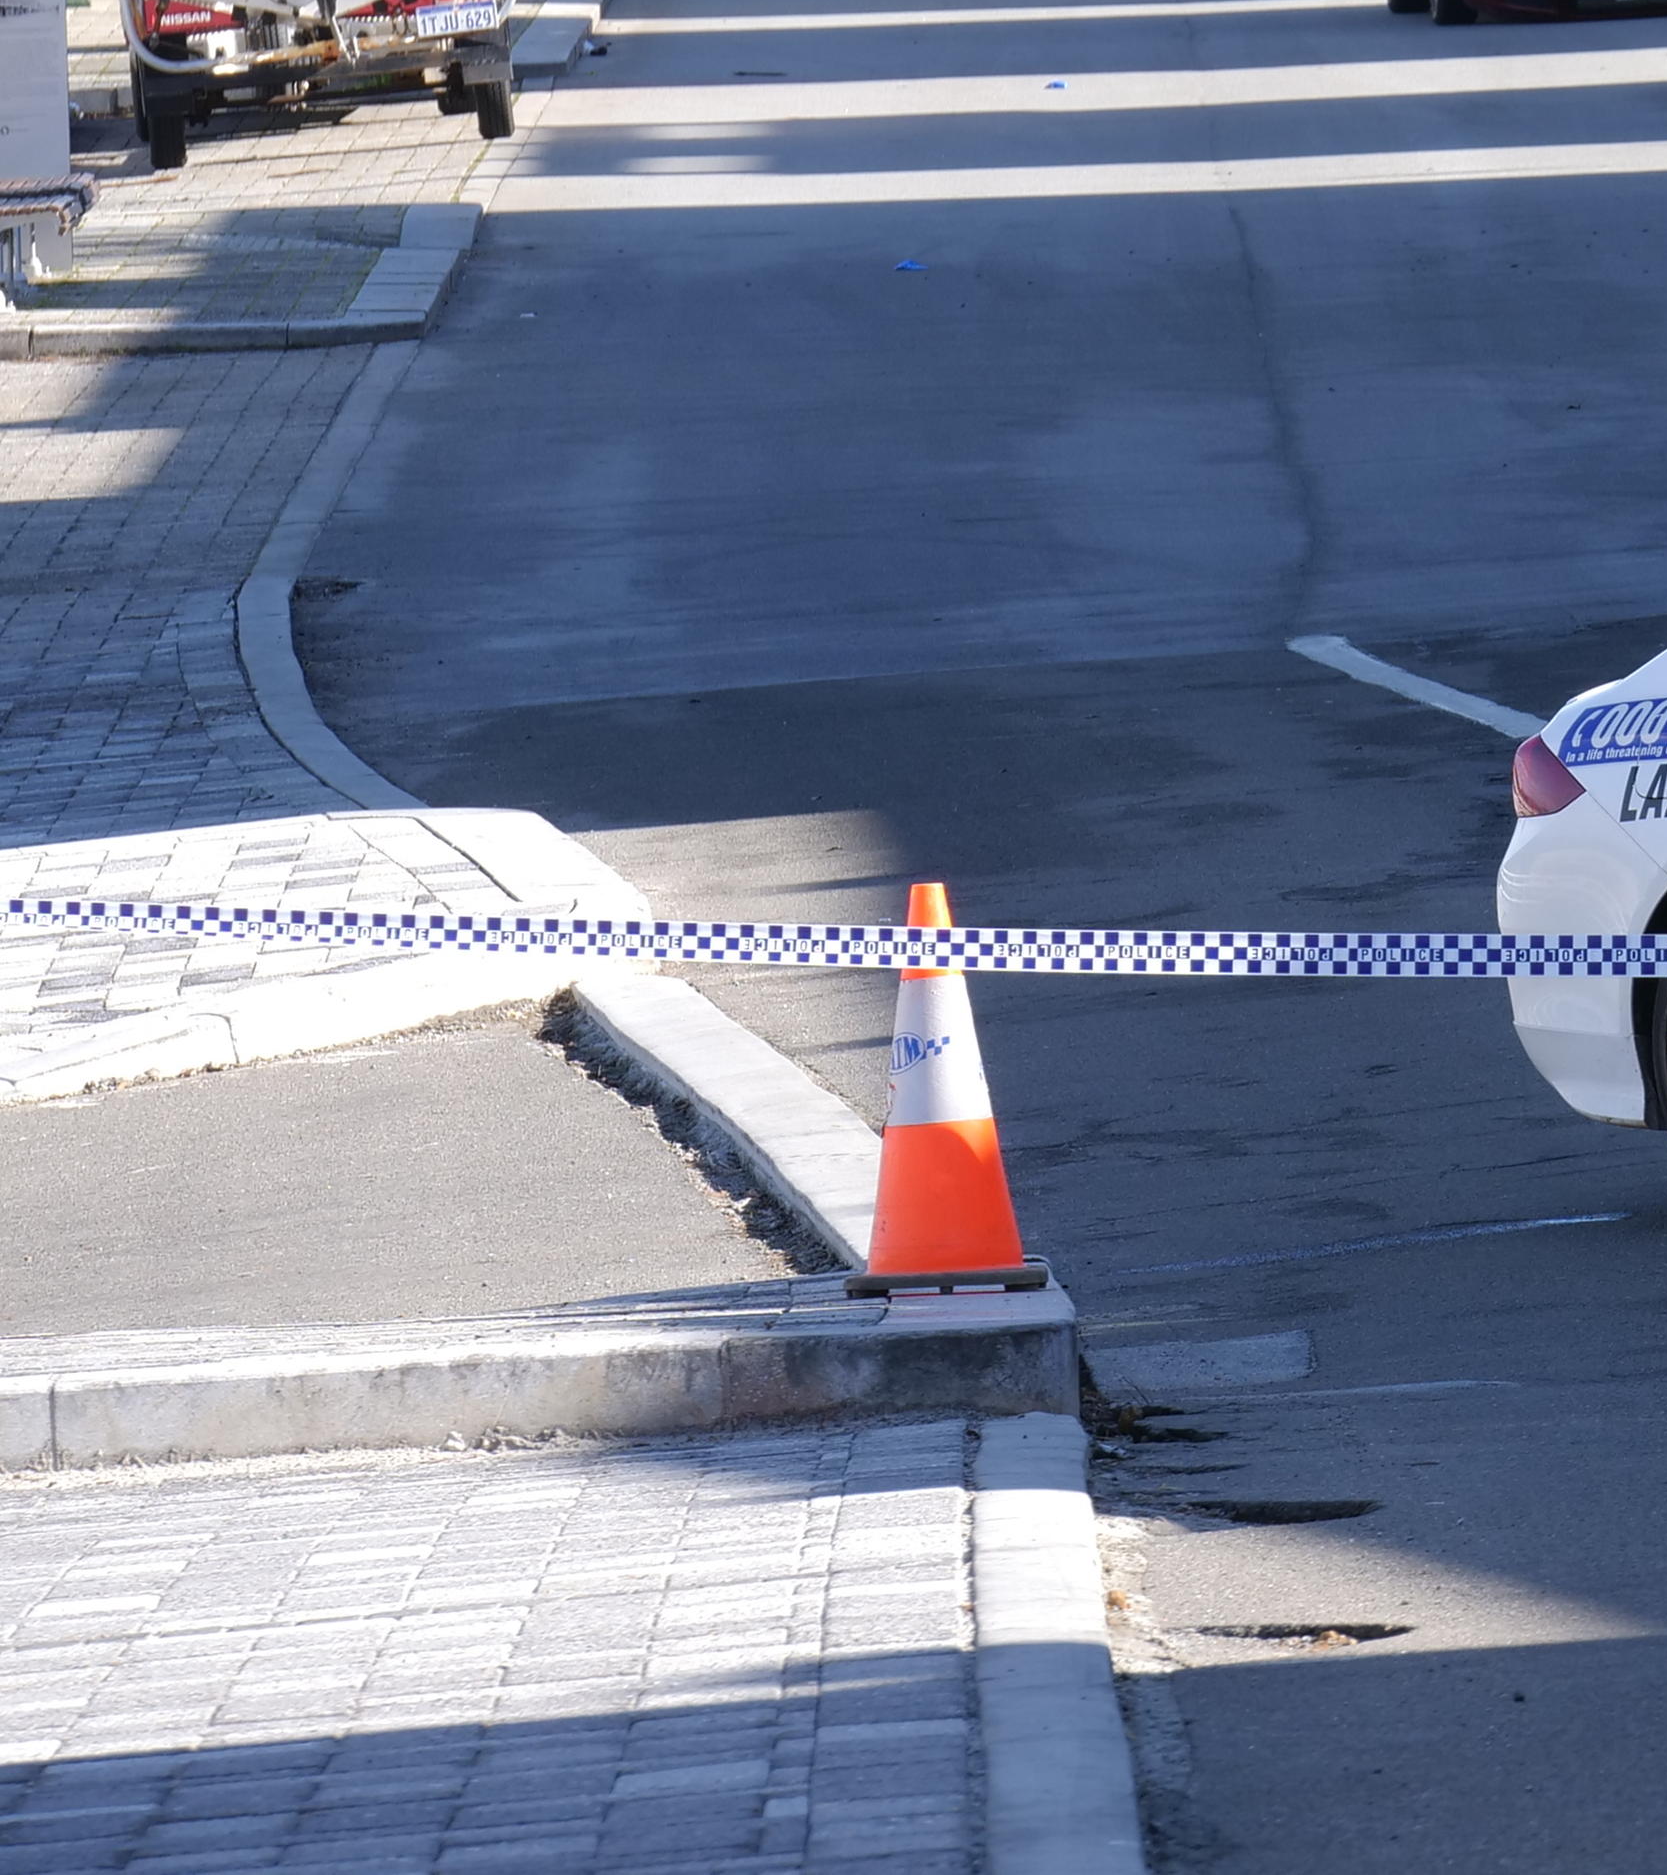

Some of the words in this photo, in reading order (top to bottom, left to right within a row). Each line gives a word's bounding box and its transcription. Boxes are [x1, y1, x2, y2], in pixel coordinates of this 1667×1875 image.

[160, 10, 211, 25] NISSAN
[1586, 749, 1603, 761] life
[1605, 744, 1663, 759] threatening
[93, 916, 174, 931] POLICE
[345, 926, 429, 941] POLICE
[600, 933, 682, 949] POLICE
[852, 939, 935, 956] POLICE
[1106, 945, 1189, 960] POLICE
[1360, 948, 1443, 962] POLICE
